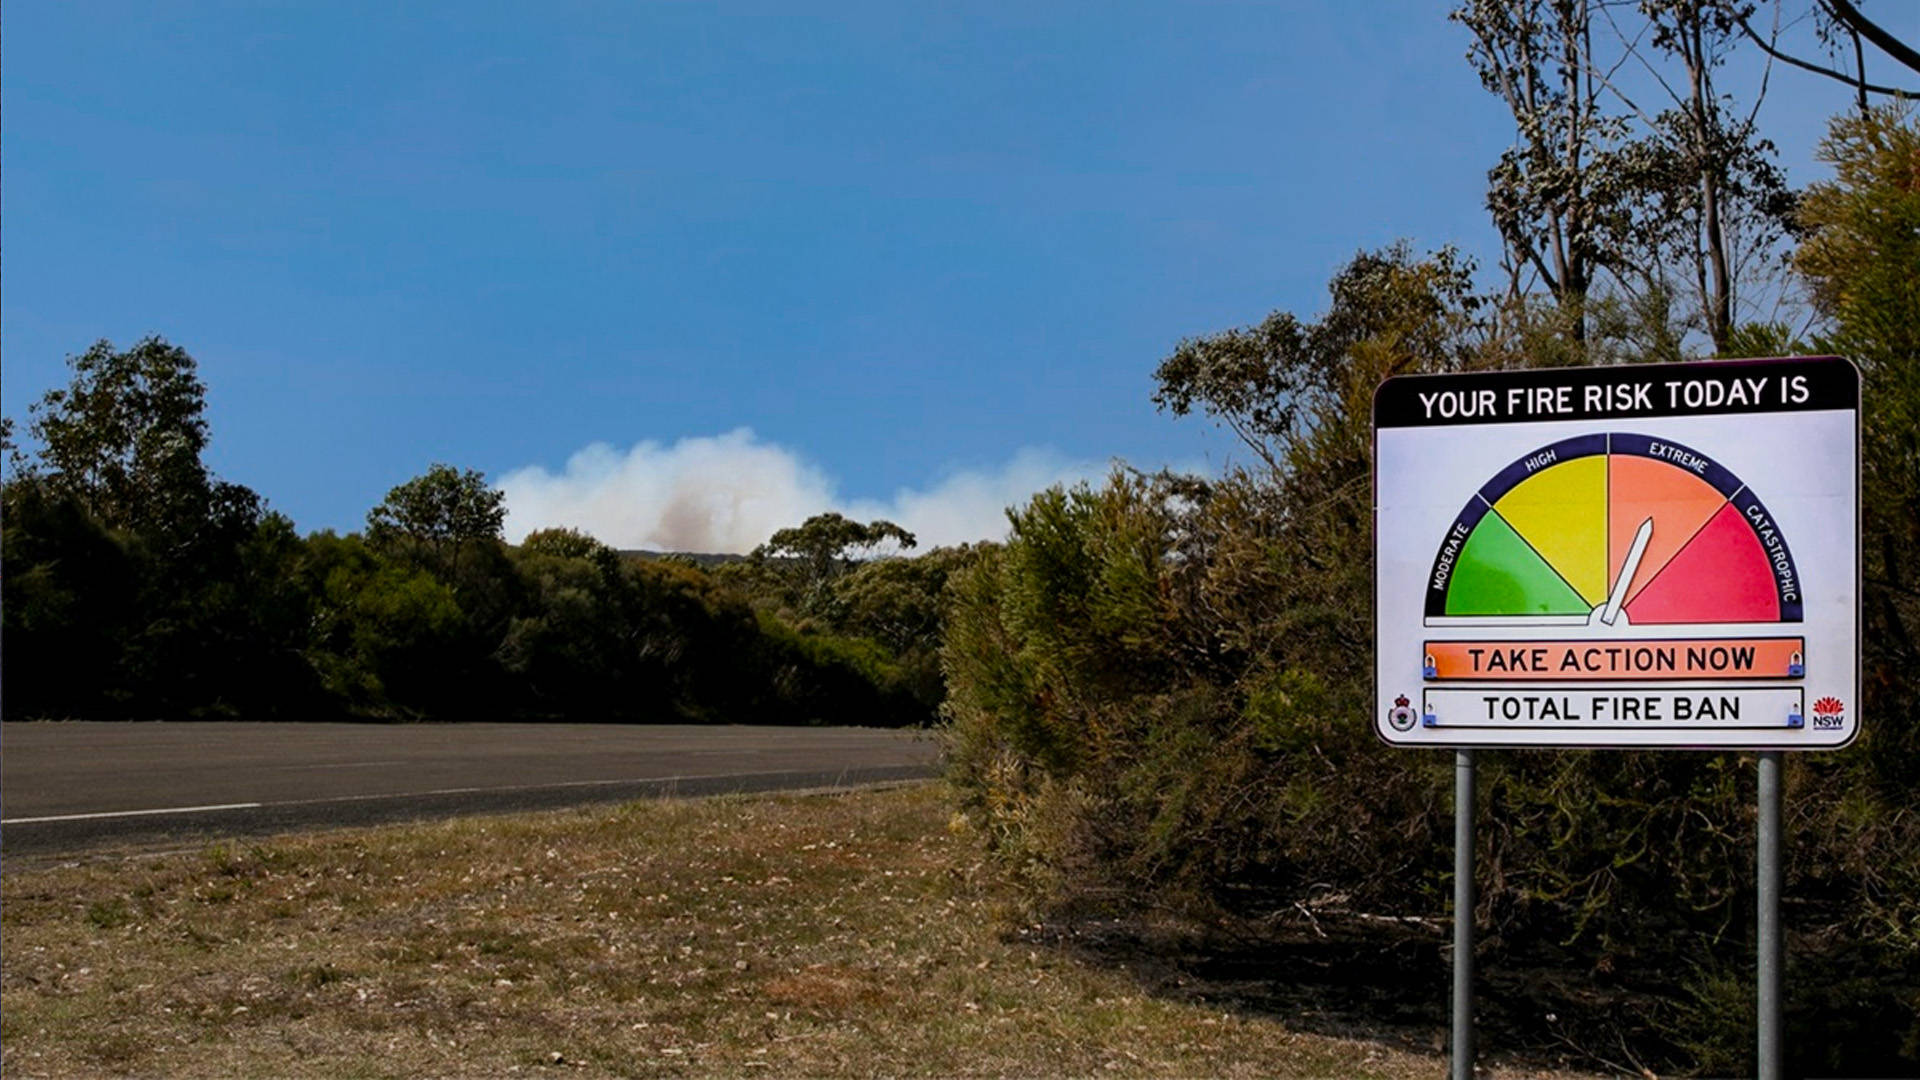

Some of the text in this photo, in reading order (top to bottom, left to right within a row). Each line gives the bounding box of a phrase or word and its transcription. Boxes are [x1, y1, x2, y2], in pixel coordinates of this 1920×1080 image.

[1418, 375, 1810, 419] YOUR FIRE RISK TODAY IS
[1524, 448, 1557, 472] HIGH
[1648, 441, 1710, 475] EXTREME
[1432, 521, 1469, 591] MODERATE
[1745, 504, 1797, 603] CATASTROPHIC
[1468, 646, 1756, 672] TAKE ACTION NOW
[1483, 696, 1740, 721] TOTAL FIRE BAN
[1813, 715, 1844, 727] NSW
